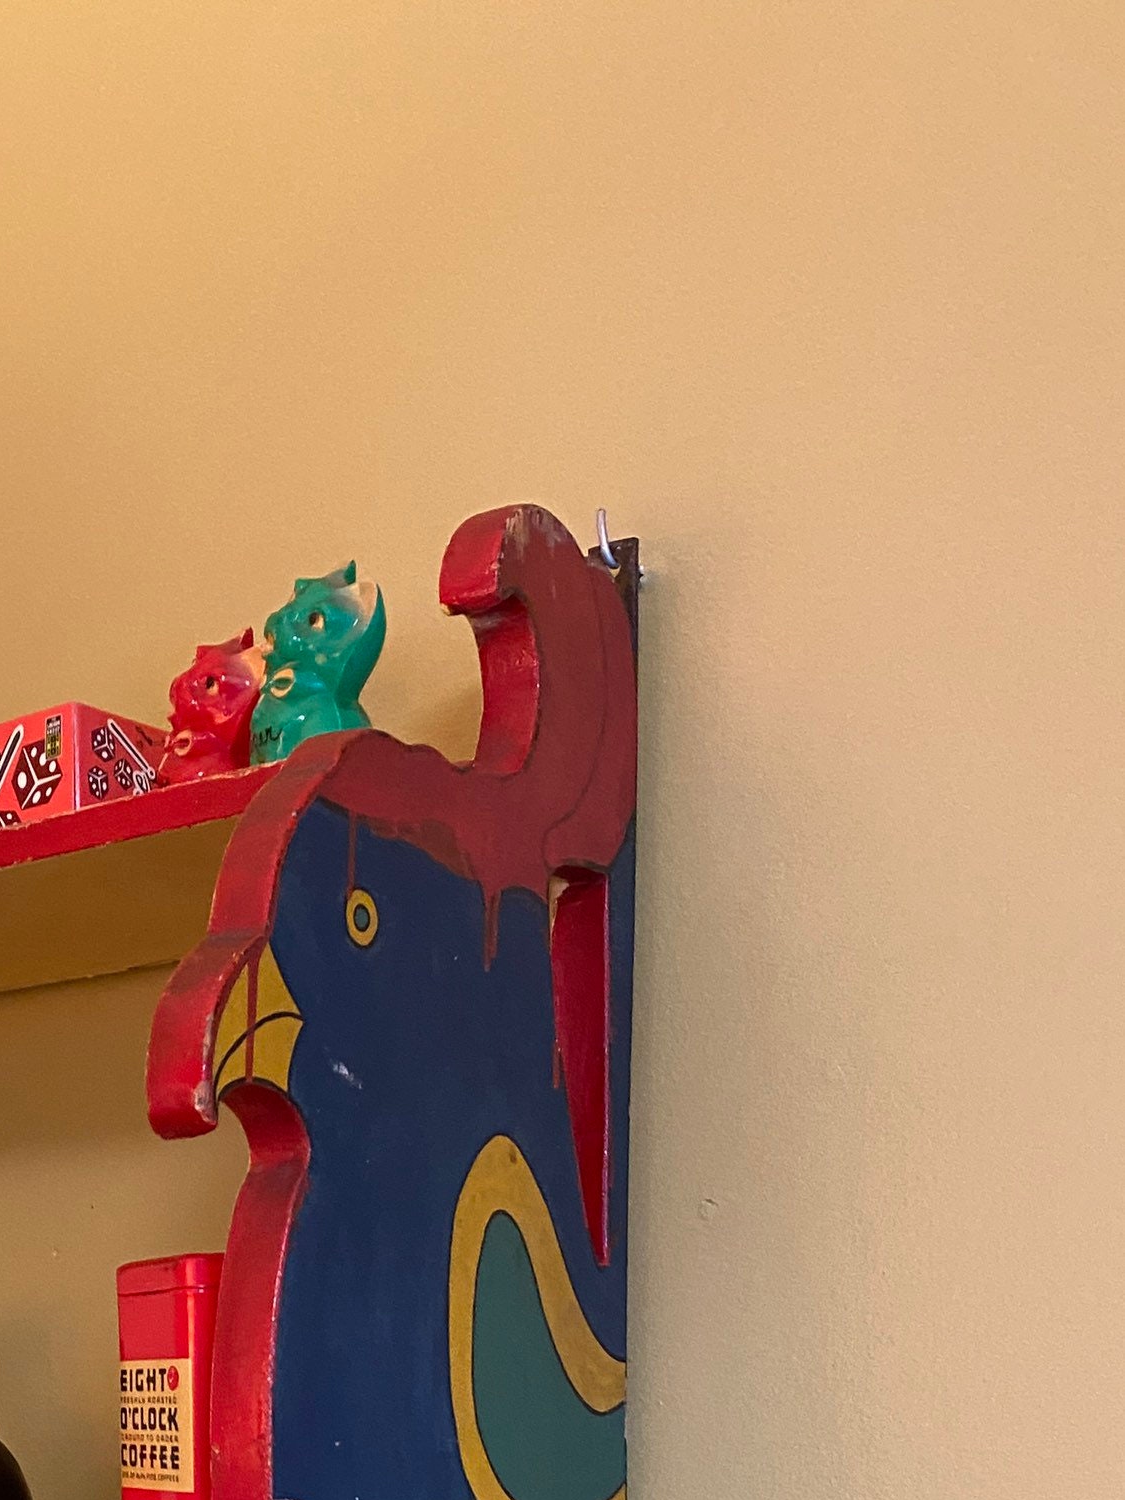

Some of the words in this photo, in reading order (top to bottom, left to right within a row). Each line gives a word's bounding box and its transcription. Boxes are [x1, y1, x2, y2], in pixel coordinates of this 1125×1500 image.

[120, 1368, 167, 1392] EIGHT
[120, 1407, 179, 1431] O'CLOCK
[121, 1443, 179, 1470] COFFEE
